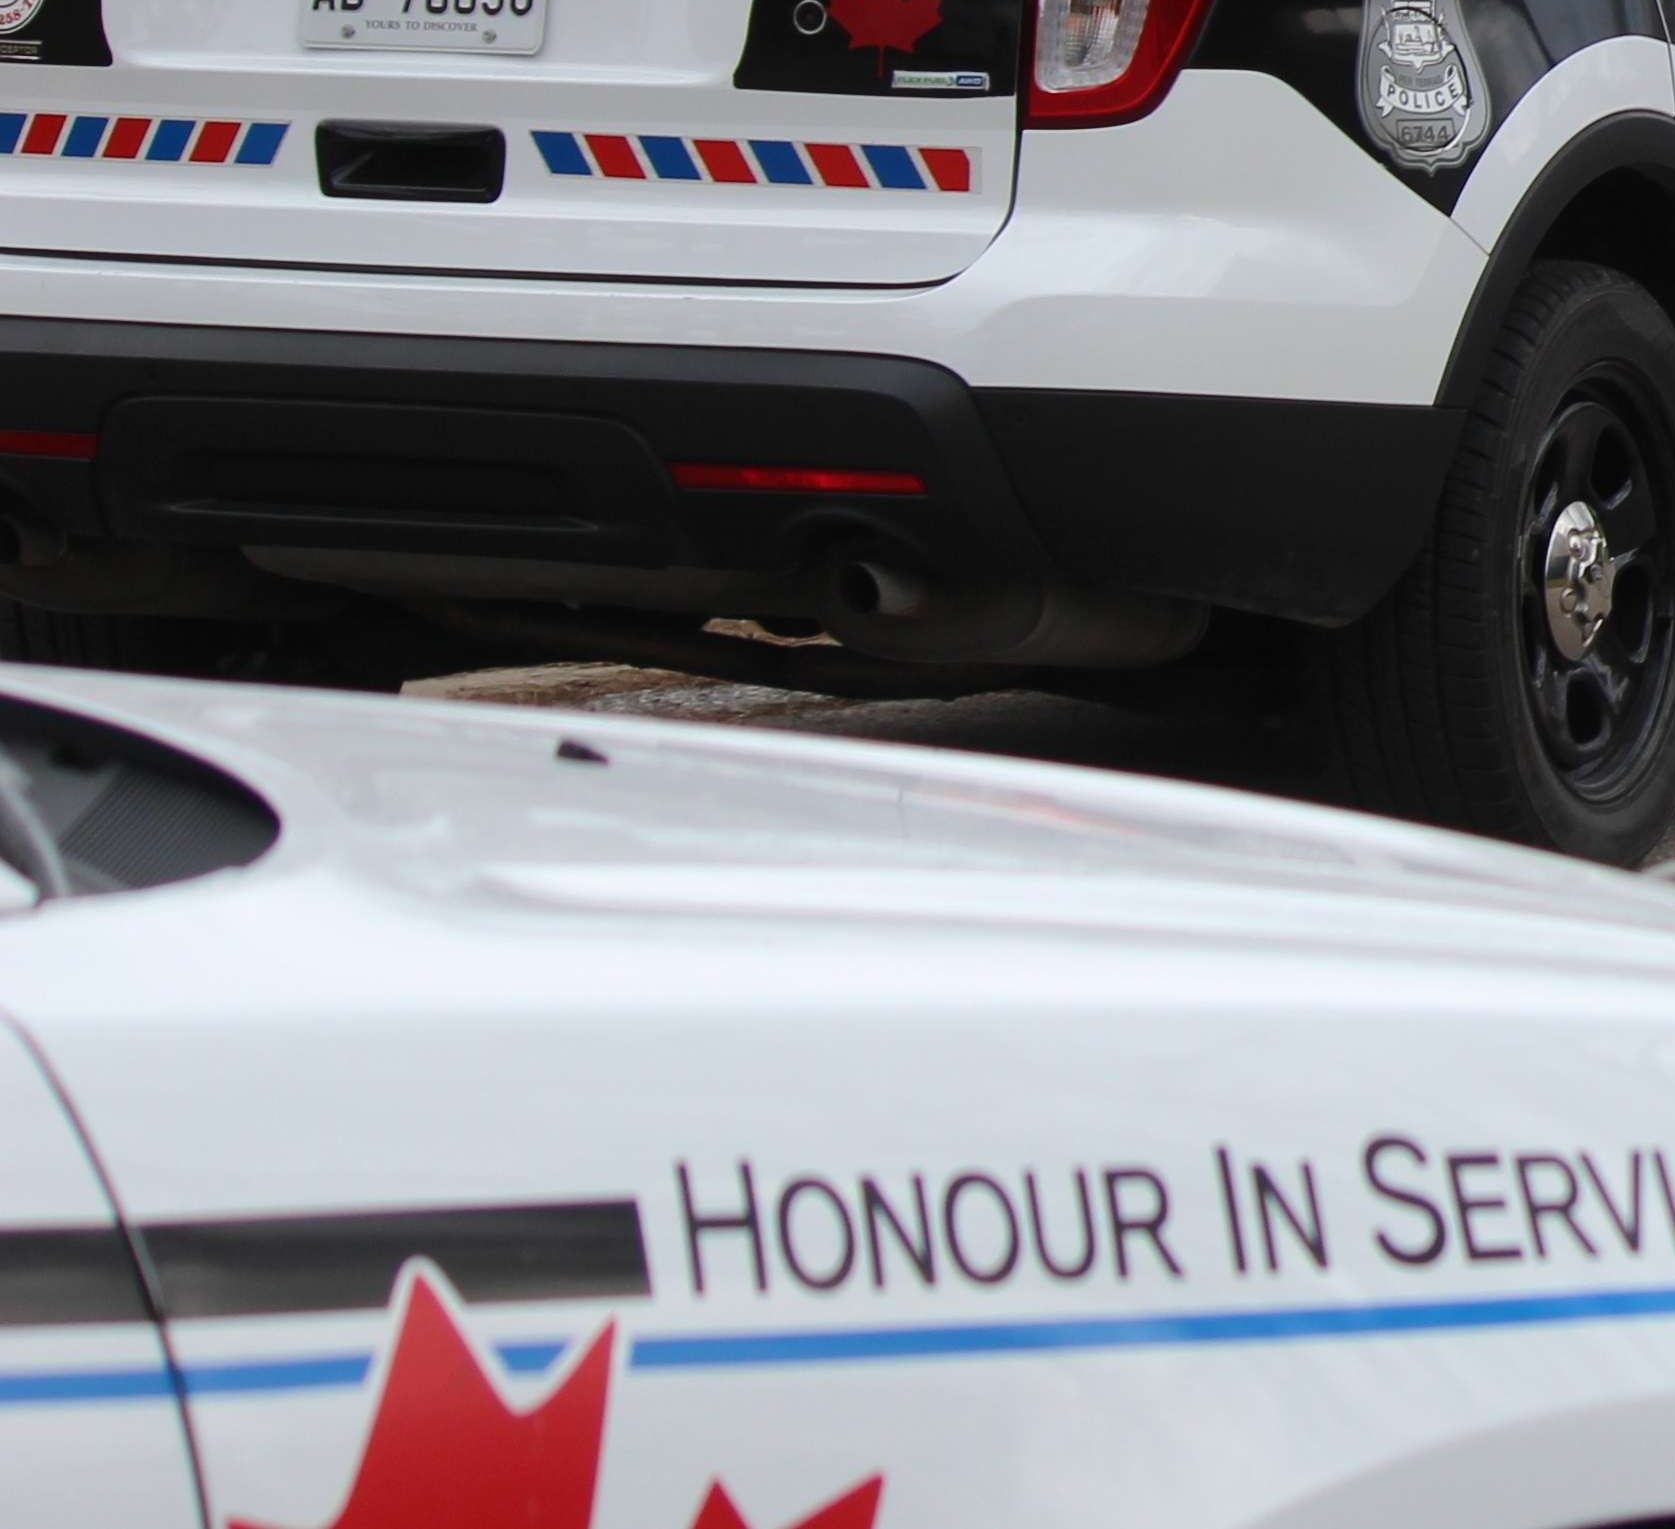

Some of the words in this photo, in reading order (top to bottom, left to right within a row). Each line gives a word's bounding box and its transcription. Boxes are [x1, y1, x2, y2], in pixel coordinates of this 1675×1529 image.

[365, 20, 400, 30] YOURS
[405, 21, 420, 30] TO
[424, 21, 478, 32] DISCOVER
[1387, 83, 1458, 108] POLICE
[676, 1159, 1187, 1294] HONOUR
[1215, 1144, 1329, 1272] IN
